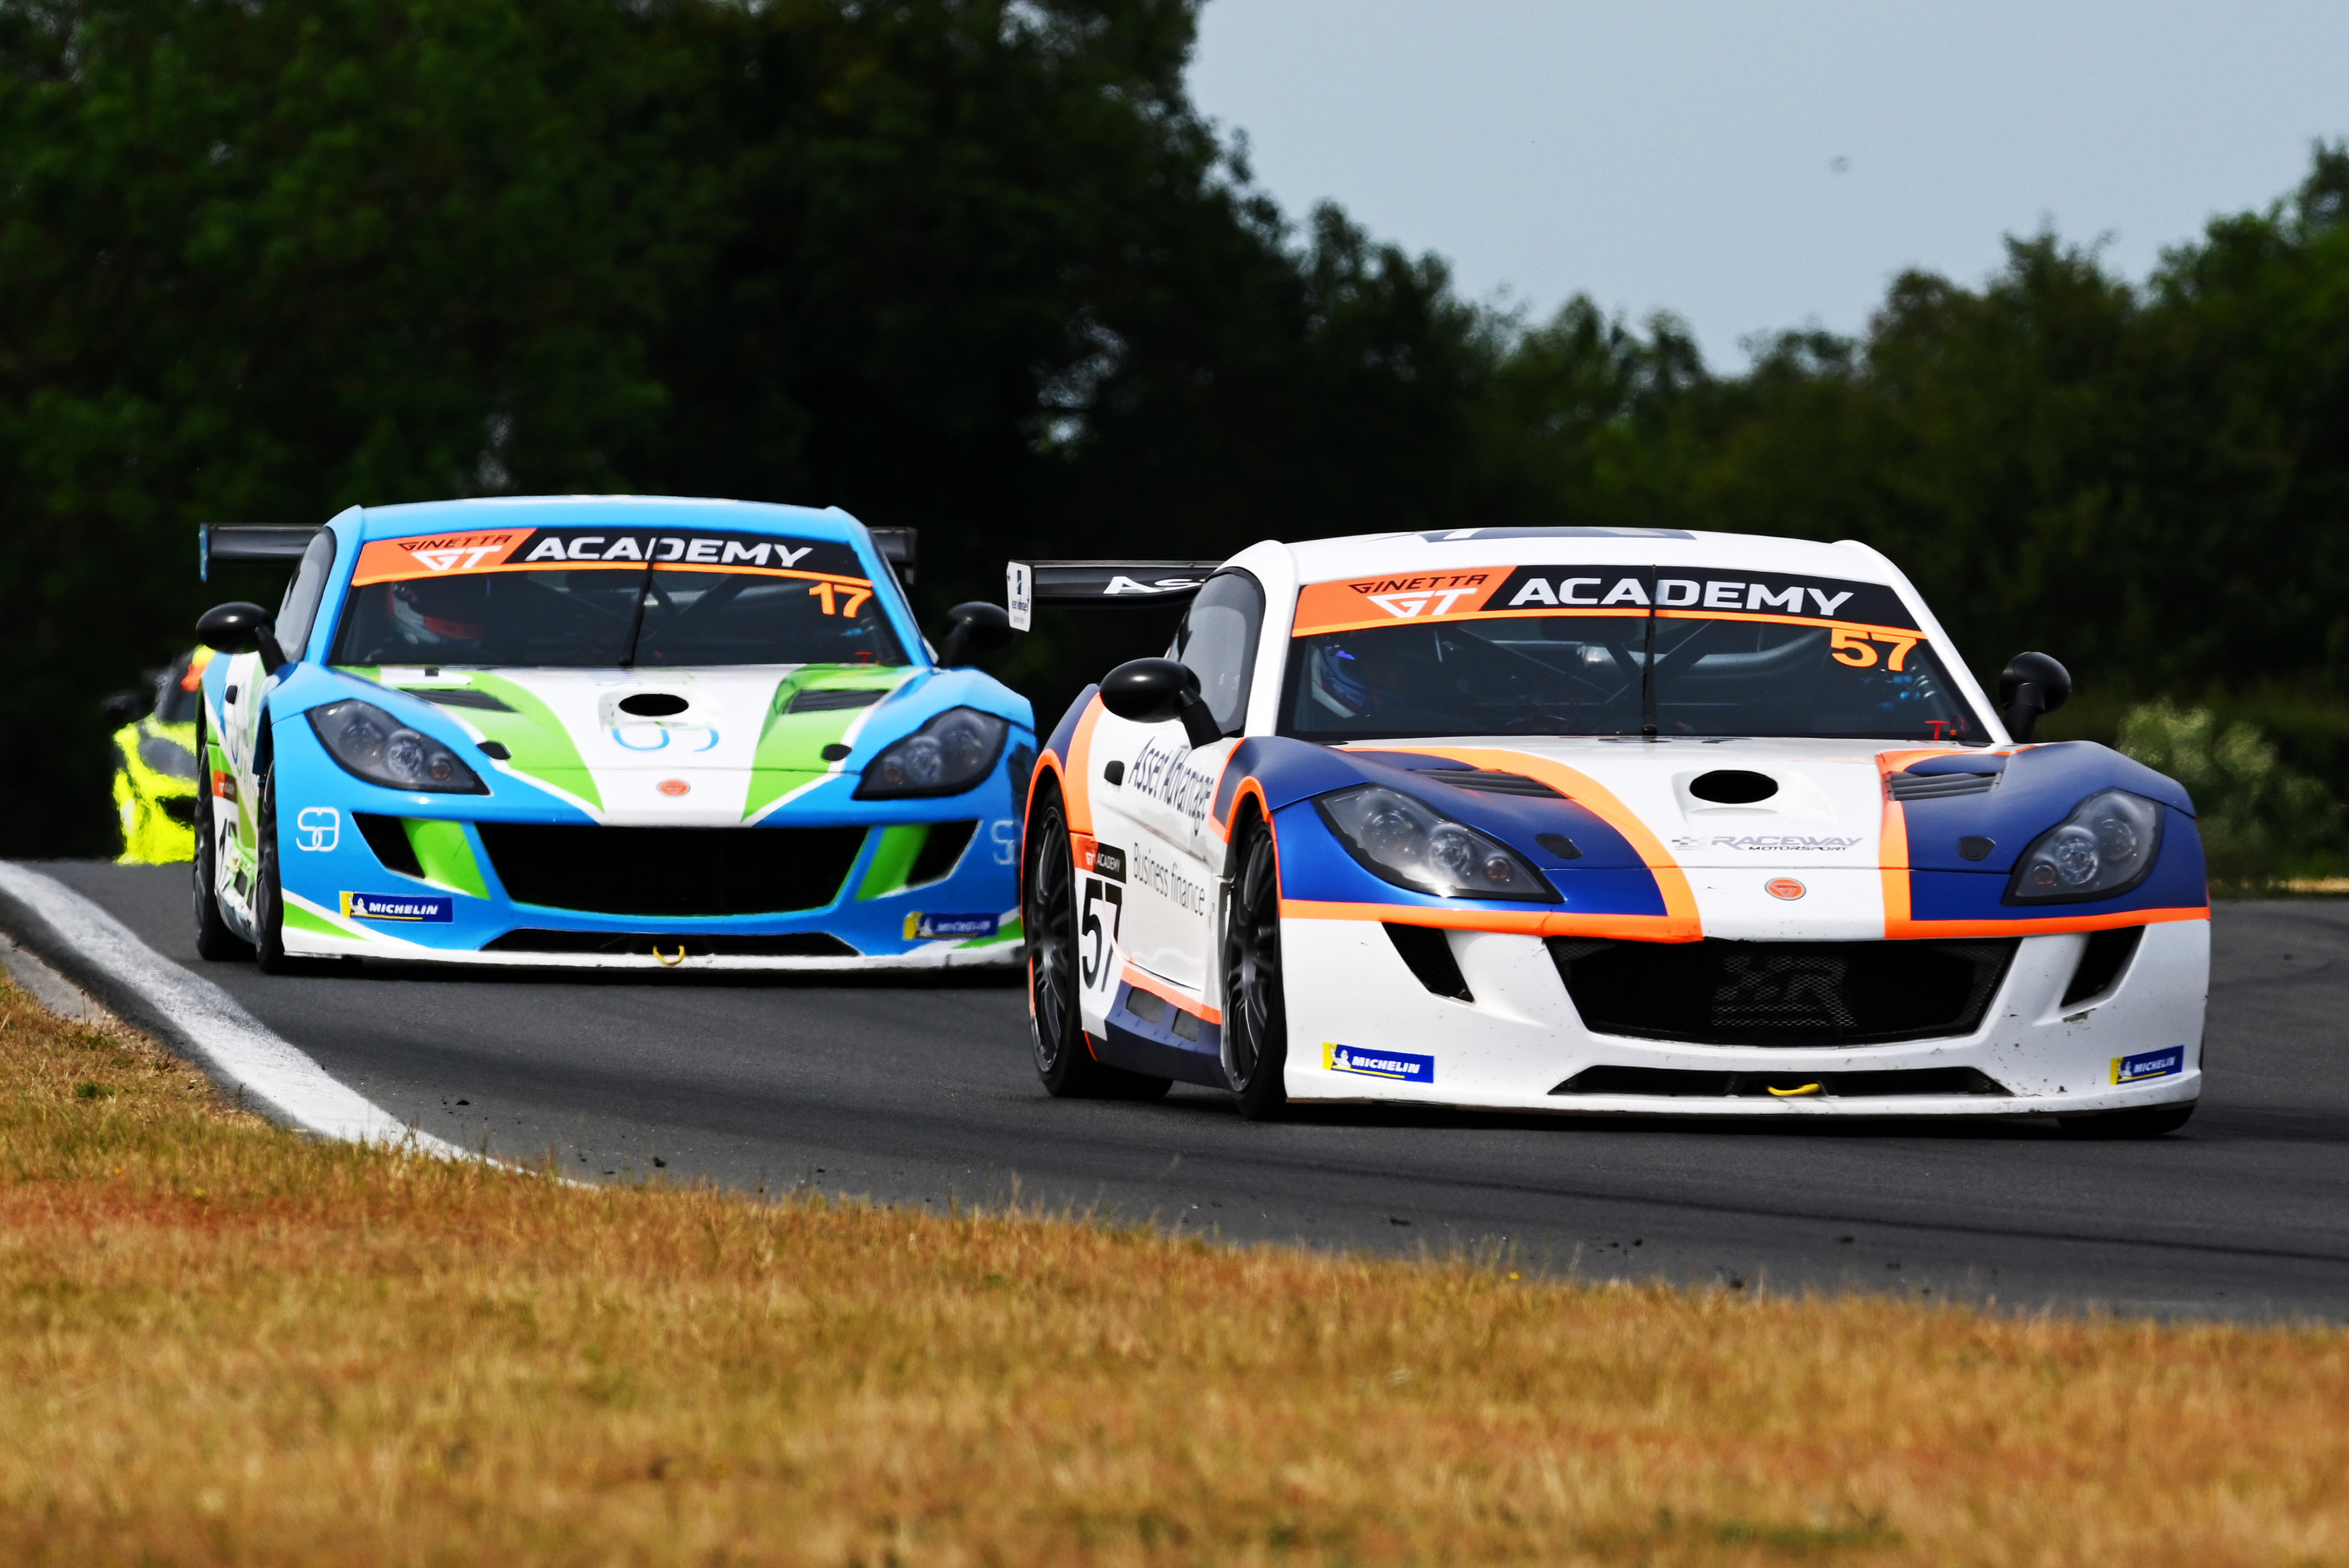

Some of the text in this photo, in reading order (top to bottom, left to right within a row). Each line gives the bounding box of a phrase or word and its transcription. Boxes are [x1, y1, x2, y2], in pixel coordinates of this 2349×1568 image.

[398, 535, 513, 552] GINETTA
[411, 536, 813, 571] GT ACADEMY
[1348, 574, 1489, 594] GINETTA
[1366, 577, 1855, 618] GT ACADEMY
[809, 581, 873, 618] 17
[1830, 628, 1918, 672] 57
[1711, 836, 1864, 851] RACEWAY
[1134, 842, 1205, 917] Business finance
[368, 901, 439, 916] MICHELIN
[1081, 877, 1123, 993] 57
[1352, 1055, 1421, 1074] MICHELIN
[2133, 1056, 2176, 1074] MICHELIN
